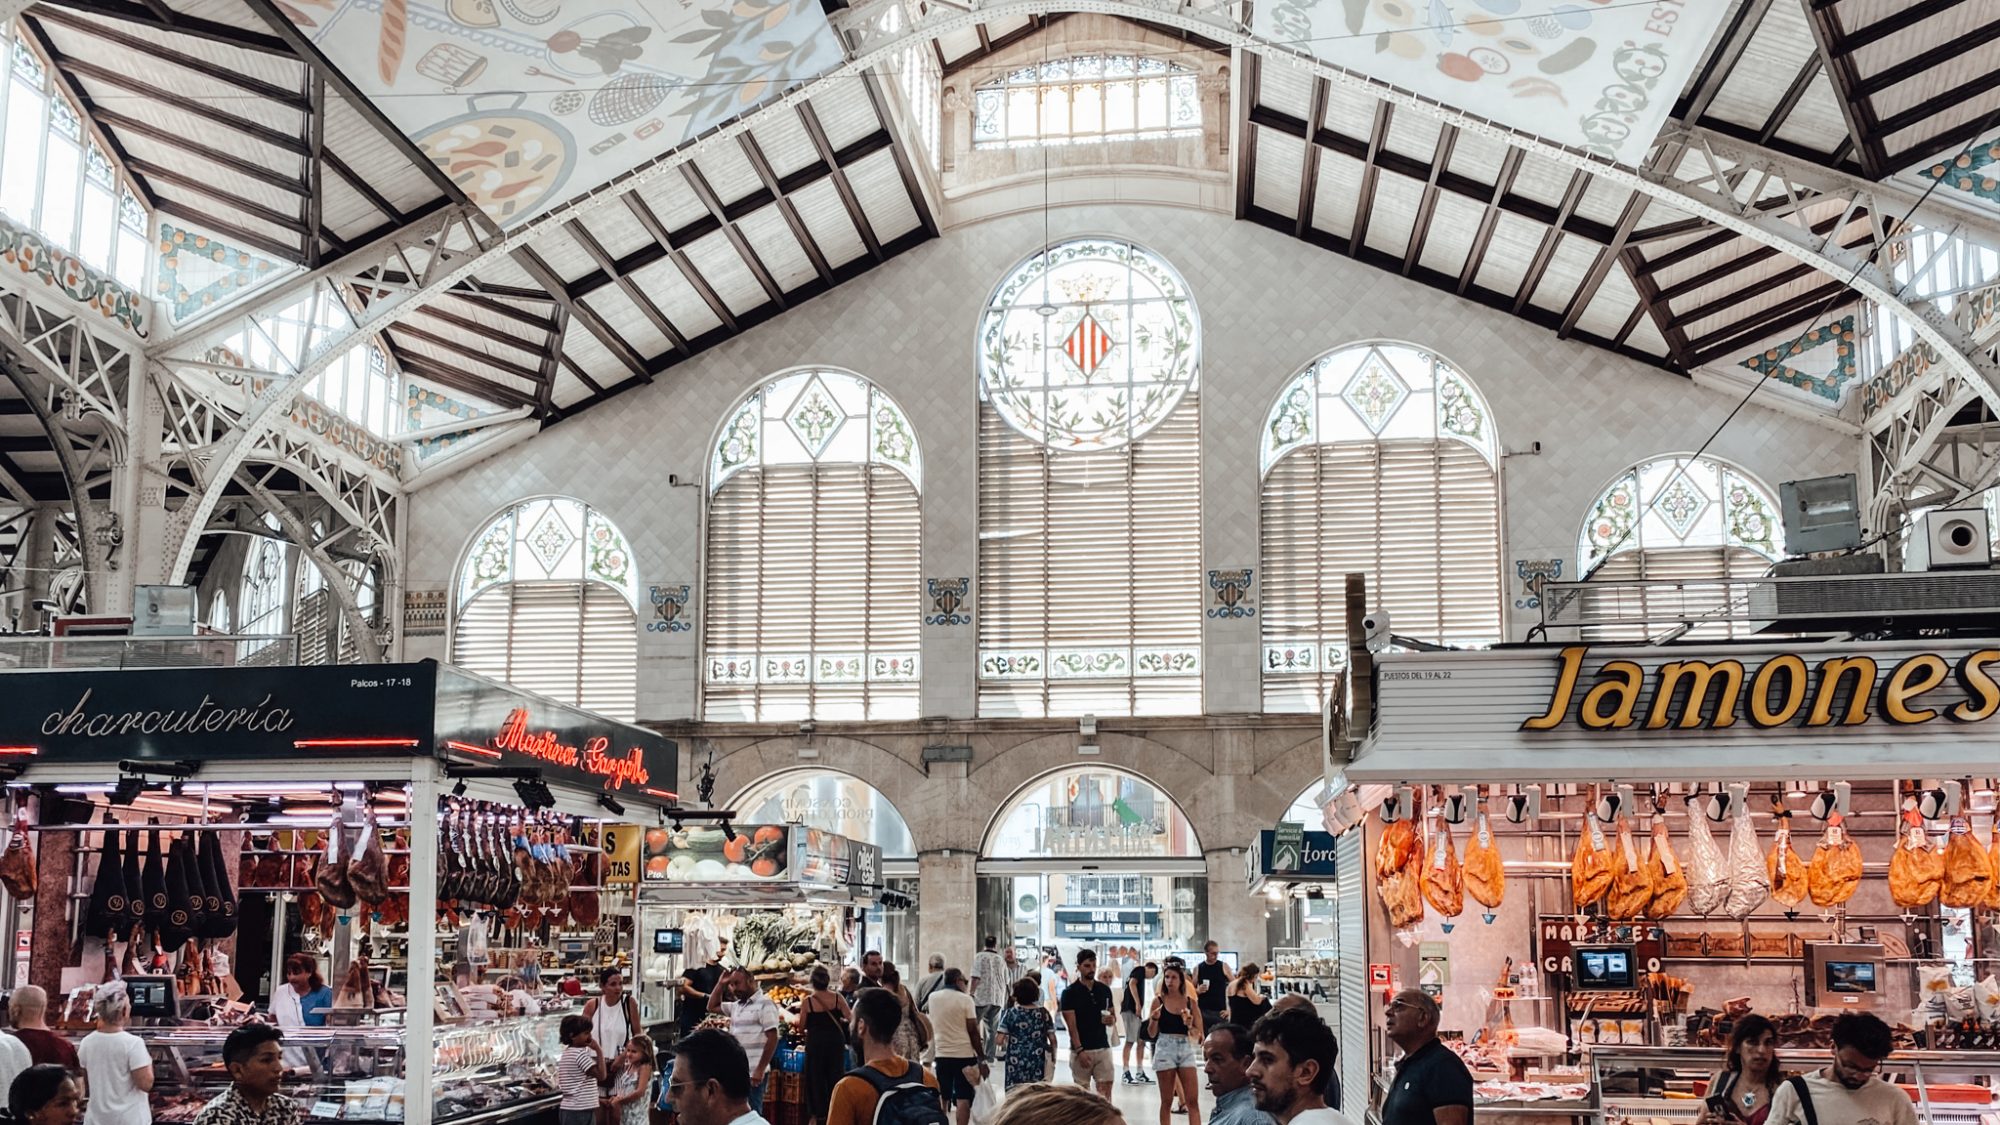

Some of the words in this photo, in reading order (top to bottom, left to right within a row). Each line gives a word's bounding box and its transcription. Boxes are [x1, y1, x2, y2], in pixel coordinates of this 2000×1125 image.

[1411, 672, 1422, 680] DEL
[1425, 672, 1433, 680] 19
[1443, 671, 1452, 679] 22
[351, 679, 378, 688] Palcos
[386, 678, 396, 687] 17
[1519, 646, 2000, 732] Jamones
[41, 687, 294, 737] charcutería
[1091, 911, 1105, 922] BAR
[1106, 911, 1119, 922] FOX
[1095, 922, 1108, 934] BAR
[1109, 922, 1122, 934] FOX
